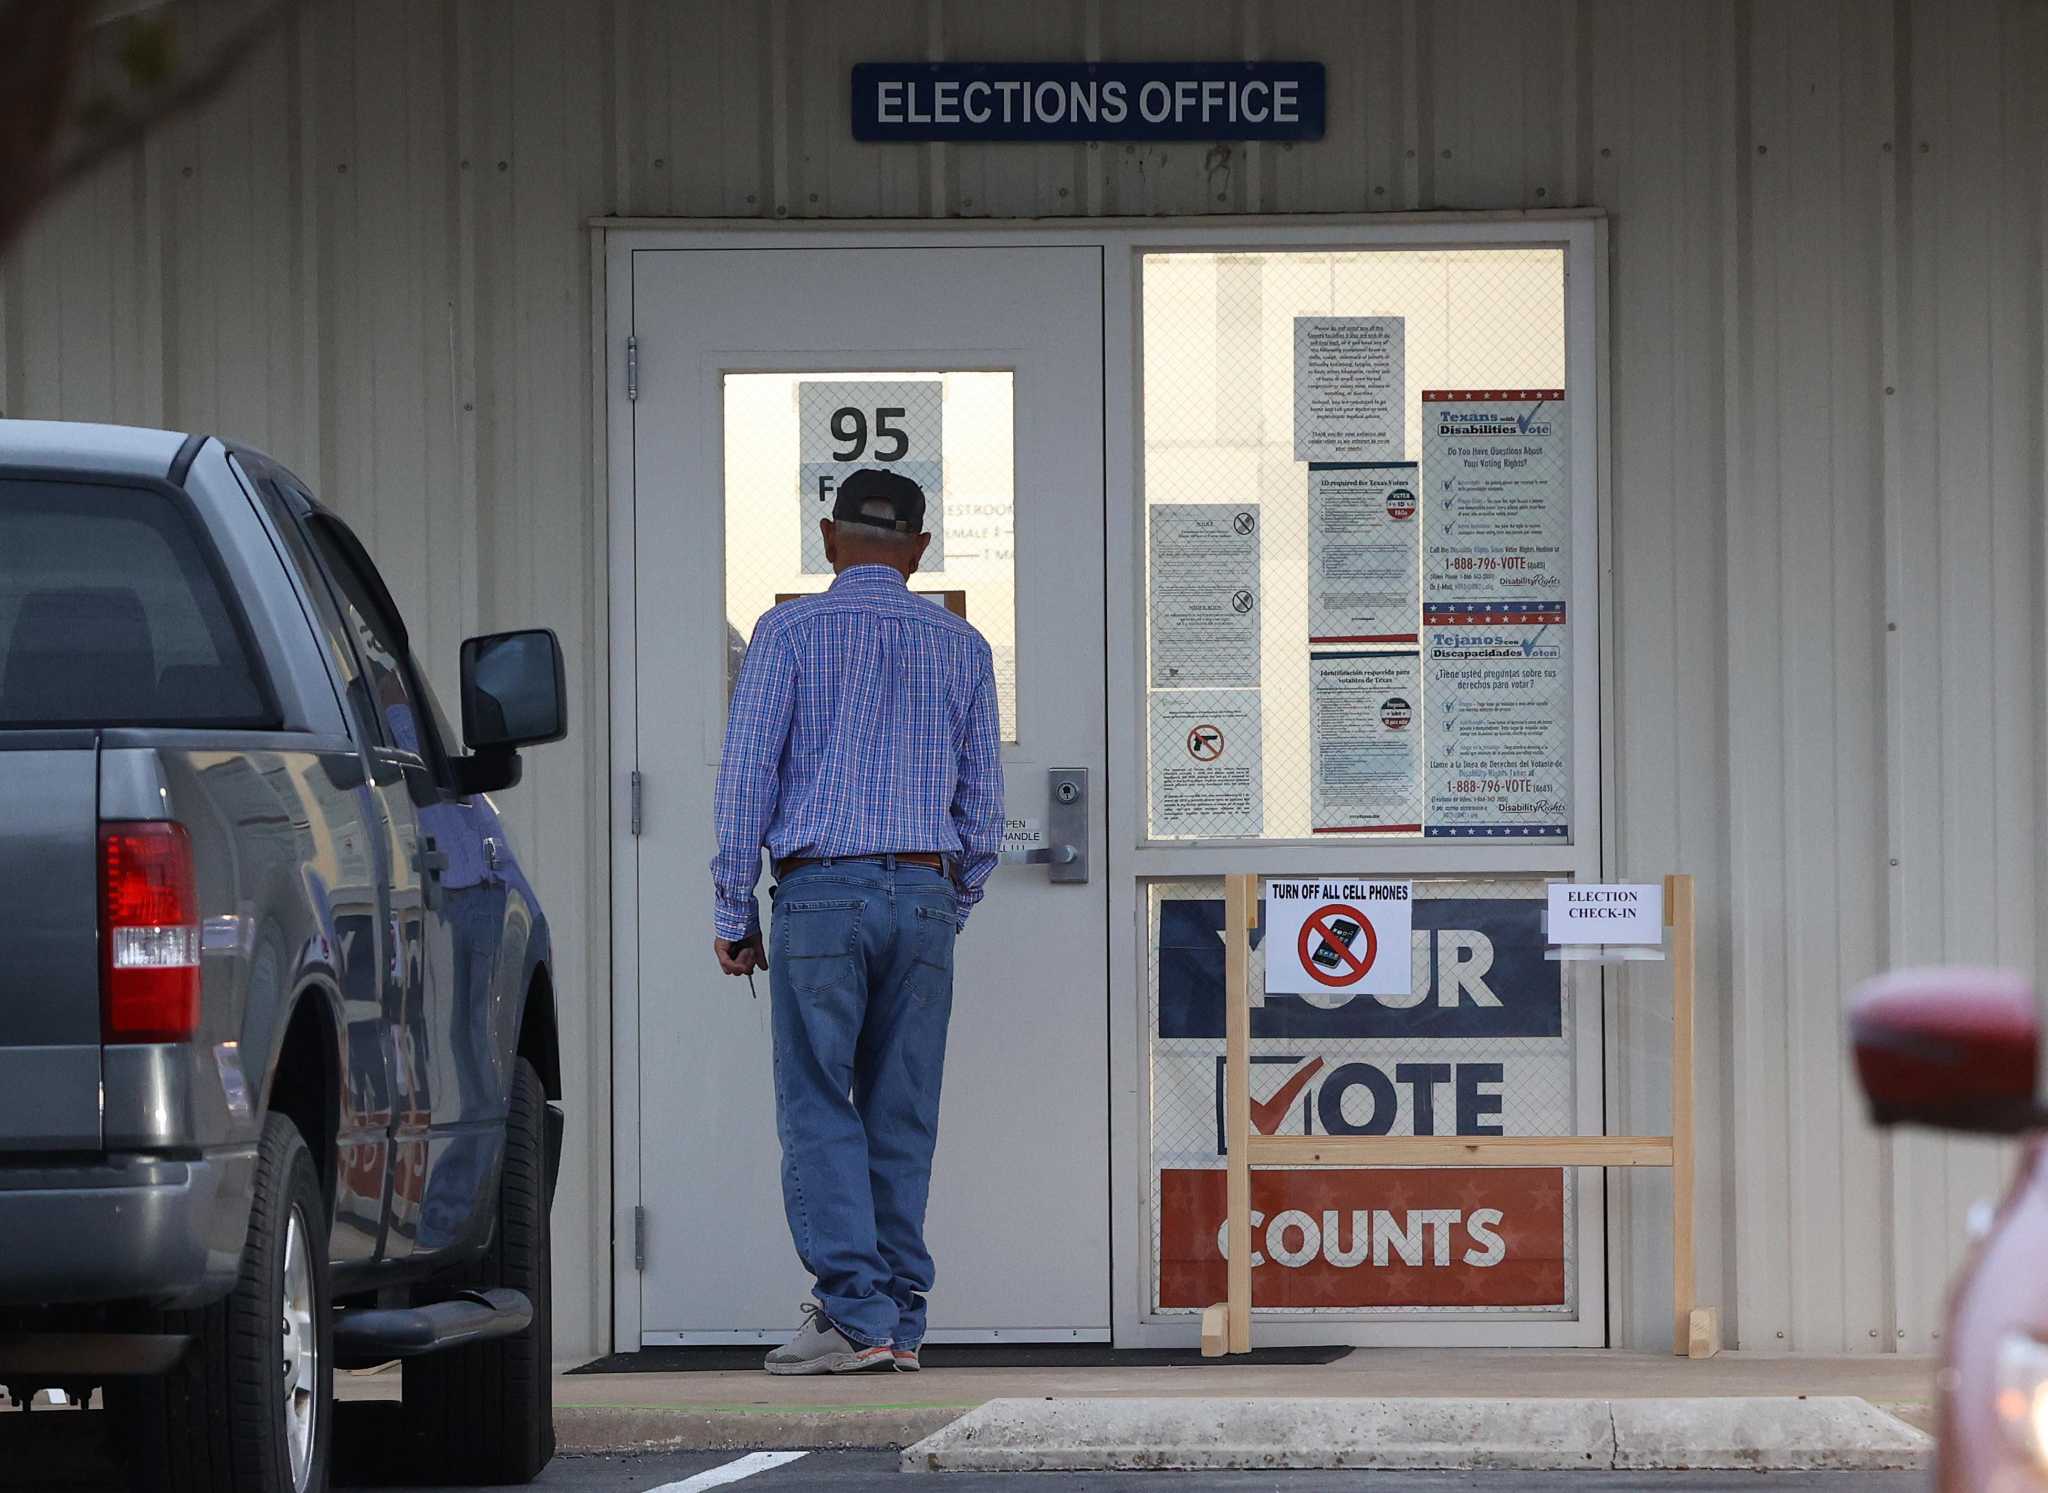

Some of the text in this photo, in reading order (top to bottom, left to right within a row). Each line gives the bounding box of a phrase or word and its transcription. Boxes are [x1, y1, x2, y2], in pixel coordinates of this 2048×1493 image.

[878, 81, 1299, 123] ELECTIONS OFFICE
[1440, 411, 1498, 422] Texans
[830, 406, 909, 462] 95
[1440, 425, 1517, 434] Disabilities
[1446, 556, 1526, 570] 1-888-796-VOTE
[1434, 634, 1503, 648] Tejanos
[1434, 650, 1522, 658] Discapacidades
[1448, 780, 1531, 792] 1-888-796-VOTE
[1006, 820, 1026, 828] PEN
[1272, 884, 1408, 899] TURN OFF ALL CELL PHONES
[1568, 892, 1638, 902] ELECTION
[1569, 908, 1636, 918] CHECK-IN
